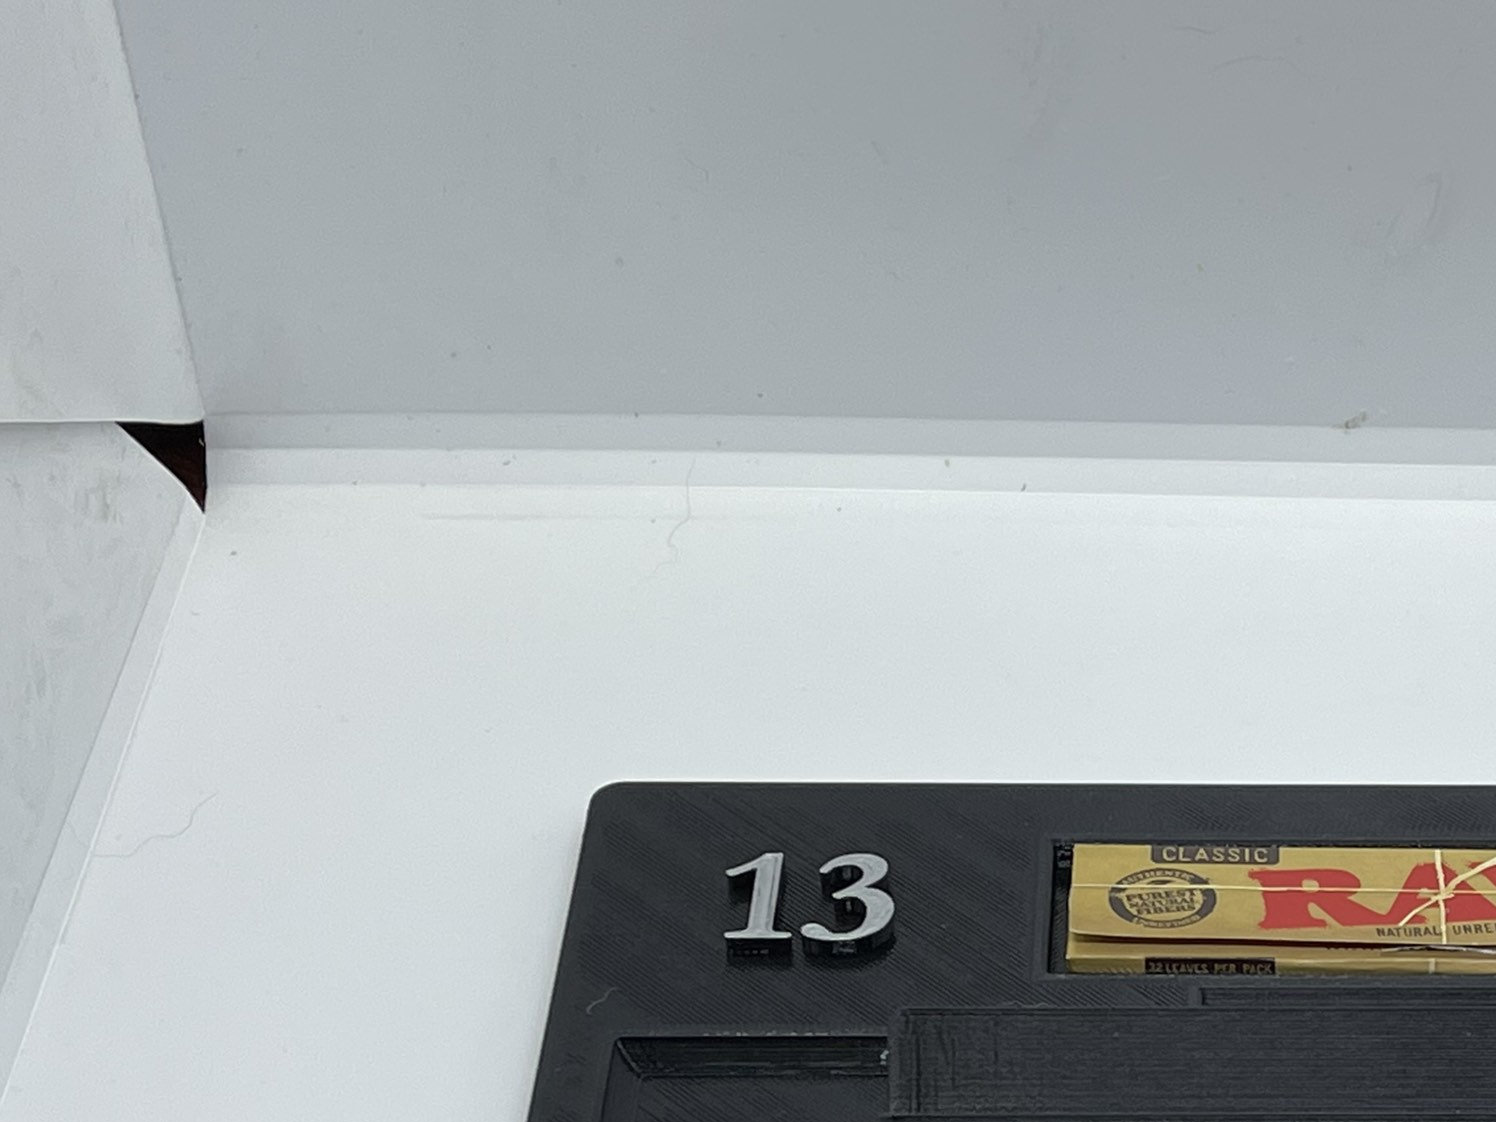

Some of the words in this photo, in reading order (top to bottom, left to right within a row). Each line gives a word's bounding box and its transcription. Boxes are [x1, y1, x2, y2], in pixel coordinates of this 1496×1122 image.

[1161, 846, 1269, 863] CLASSIC
[723, 851, 895, 942] 13
[1375, 925, 1443, 938] NATURAL
[1166, 962, 1210, 974] LEAVES
[1213, 963, 1237, 974] PER
[1242, 963, 1273, 974] PACK
